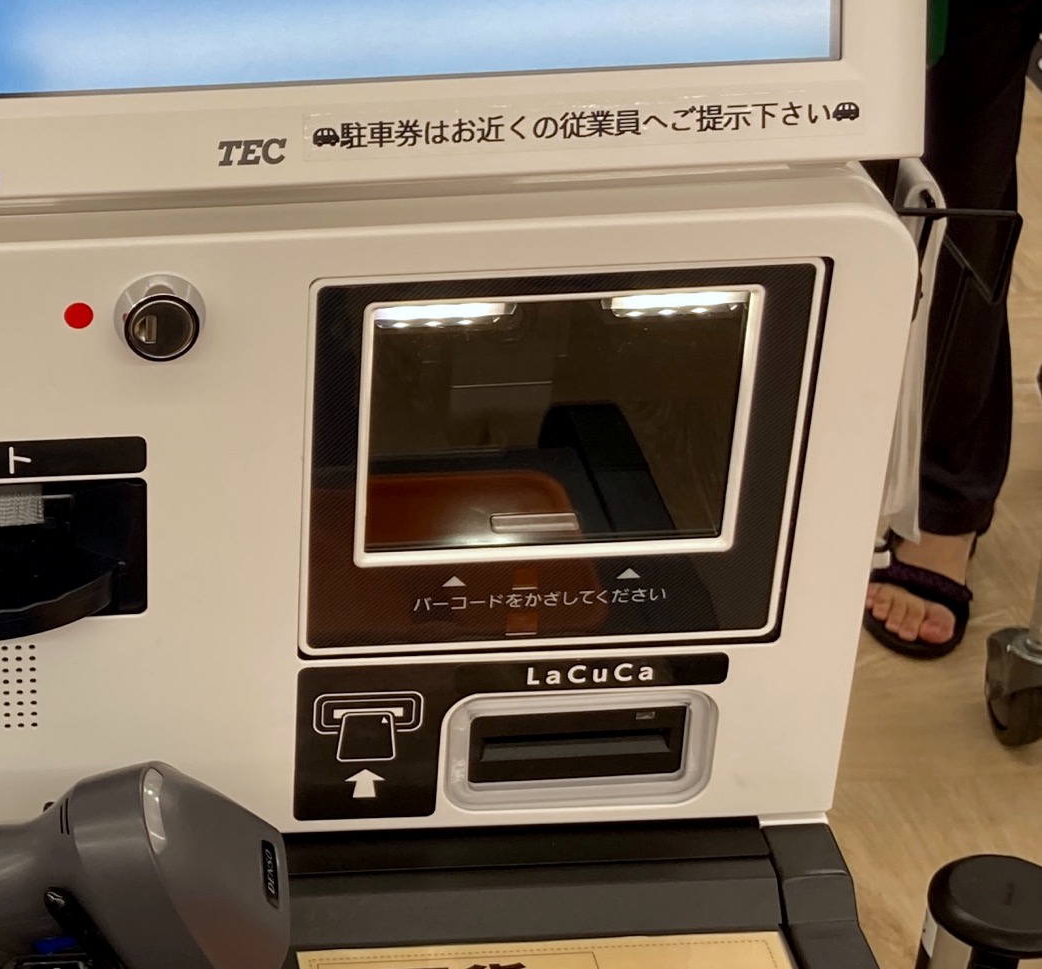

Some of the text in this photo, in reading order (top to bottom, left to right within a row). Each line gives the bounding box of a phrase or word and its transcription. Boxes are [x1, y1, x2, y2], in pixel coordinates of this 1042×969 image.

[339, 100, 832, 150] 駐車券はお近くの従業員へご提示下さい
[218, 137, 287, 167] TEC
[413, 587, 667, 612] バーコードをかざしてください
[526, 662, 655, 686] LaCuCa
[264, 848, 276, 895] DENSO
